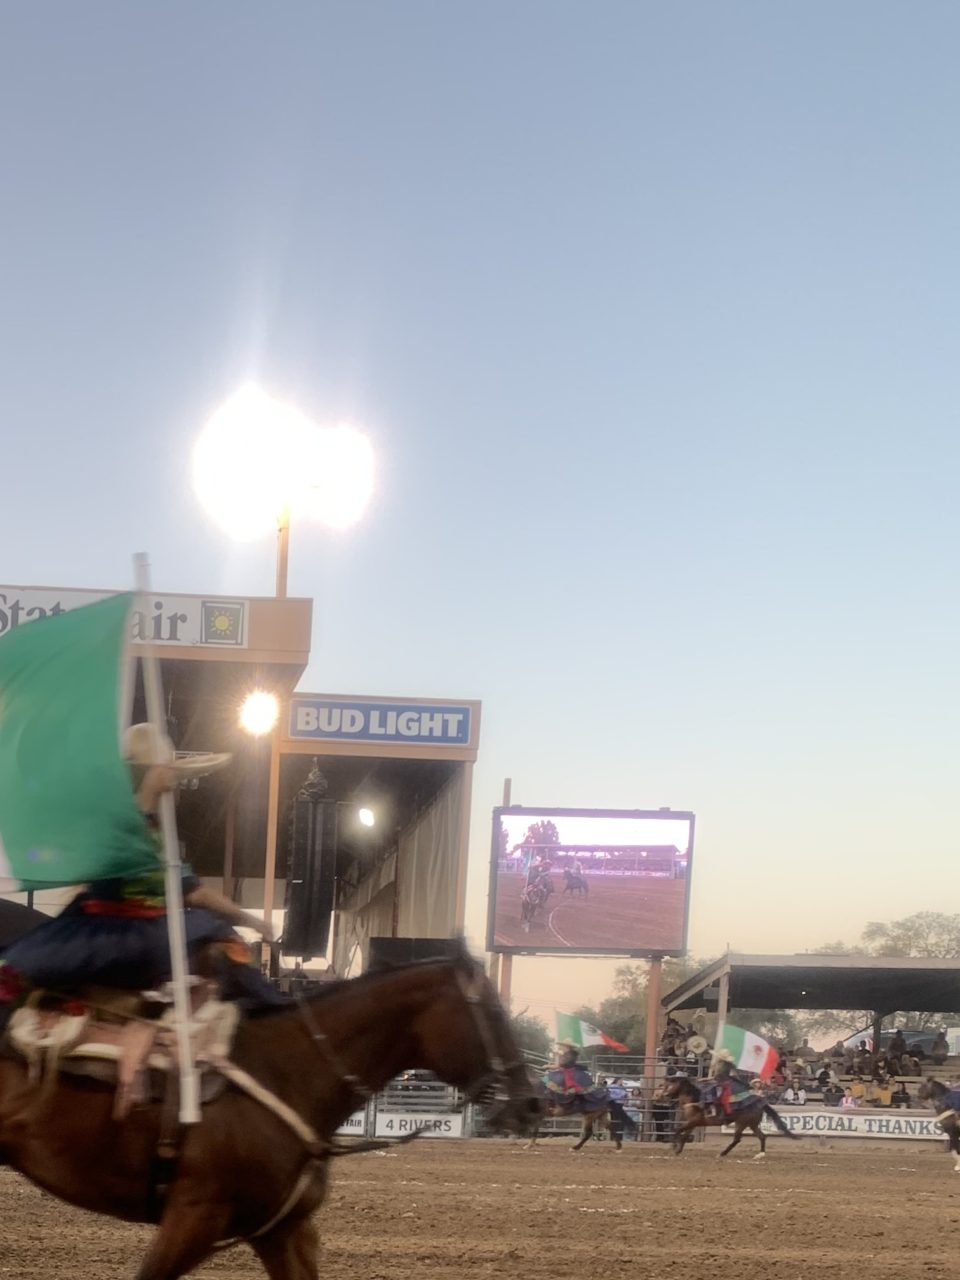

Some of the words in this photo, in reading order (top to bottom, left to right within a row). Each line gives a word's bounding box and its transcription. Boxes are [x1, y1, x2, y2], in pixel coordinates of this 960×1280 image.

[131, 601, 188, 641] air
[296, 707, 365, 733] BUD
[369, 710, 464, 737] LIGHT
[346, 1119, 362, 1127] FAIR
[385, 1119, 395, 1131] 4
[399, 1119, 452, 1132] RIVERS
[864, 1118, 945, 1136] THANKS
